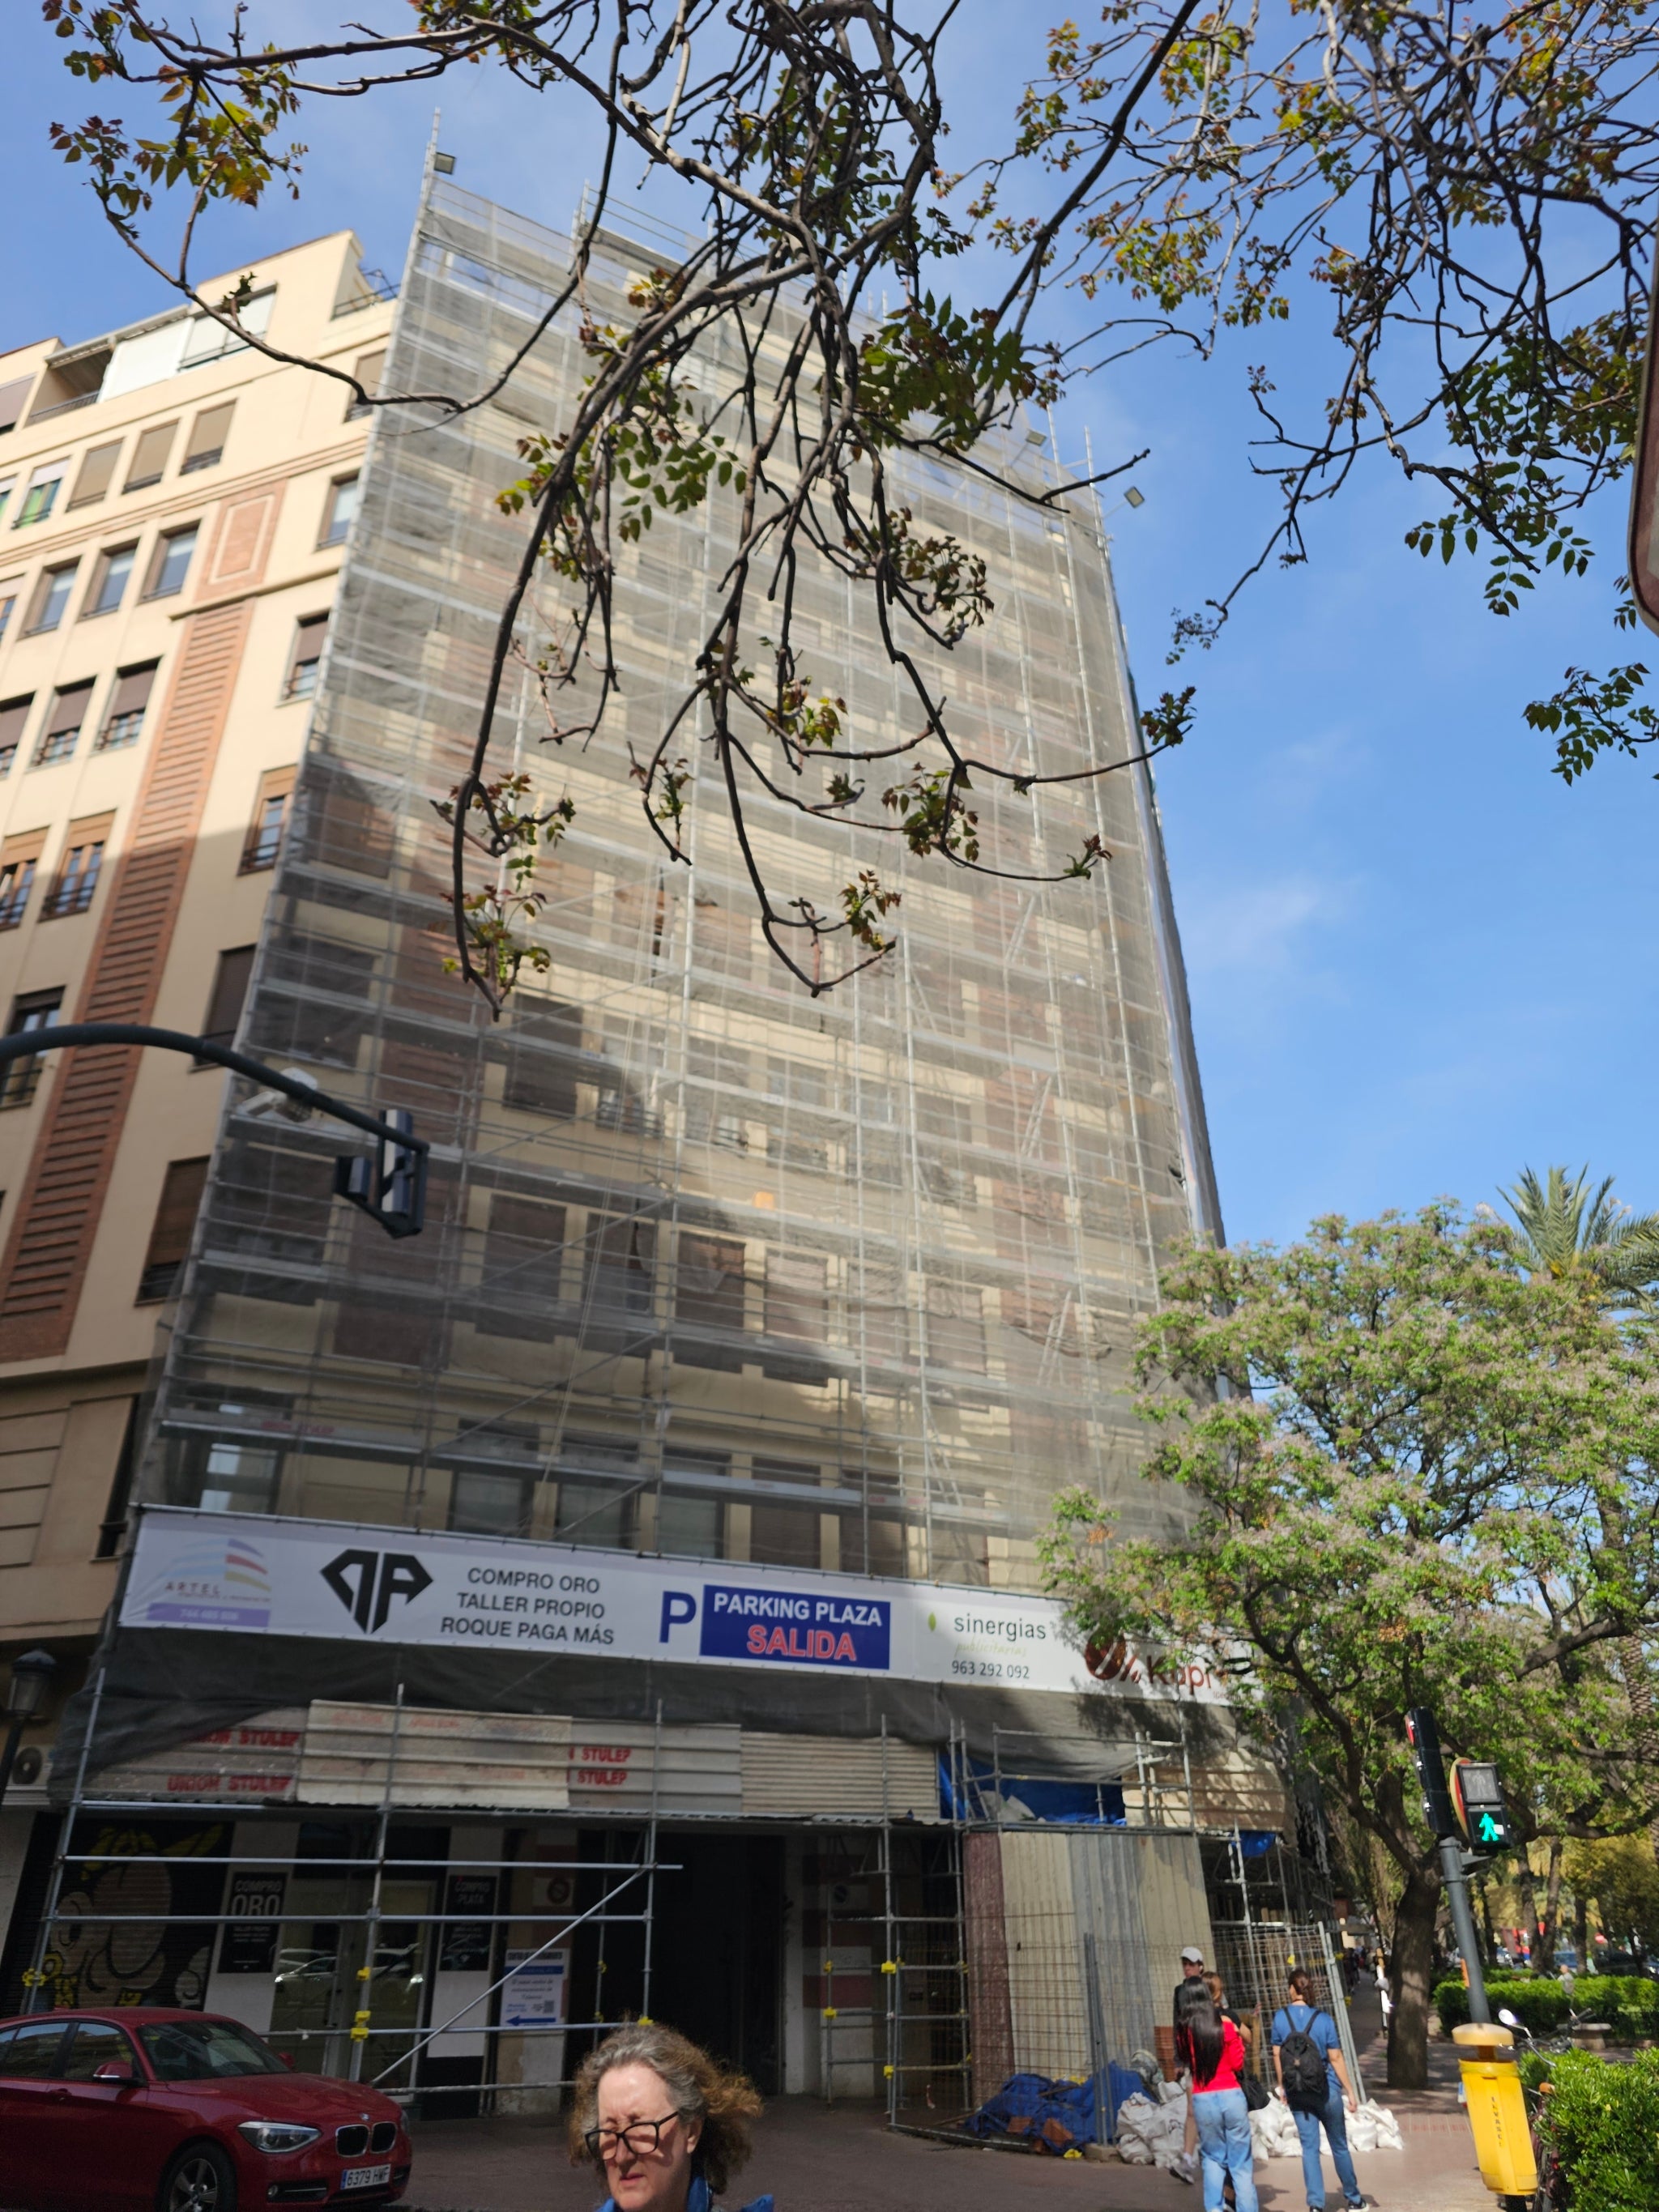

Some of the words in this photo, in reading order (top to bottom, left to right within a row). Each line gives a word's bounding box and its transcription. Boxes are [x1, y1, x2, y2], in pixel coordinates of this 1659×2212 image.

[164, 1581, 220, 1595] ARTEL
[467, 1567, 553, 1589] COMPRO
[559, 1575, 600, 1594] ORO
[457, 1592, 528, 1613] TALLER
[534, 1597, 605, 1619] PROPIO
[659, 1591, 697, 1643] P
[713, 1592, 810, 1620] PARKING
[815, 1601, 882, 1627] PLAZA
[441, 1617, 512, 1637] ROQUE
[517, 1622, 569, 1642] PAGA
[574, 1623, 615, 1646] MÁS
[953, 1613, 1047, 1642] sinergias
[746, 1624, 857, 1662] SALIDA
[951, 1660, 975, 1675] 963
[979, 1661, 1003, 1677] 292
[1006, 1664, 1030, 1679] 092
[581, 1746, 632, 1763] STULEP
[577, 1768, 628, 1786] STULEP
[231, 1894, 280, 1918] ORO
[348, 2170, 371, 2186] 6379
